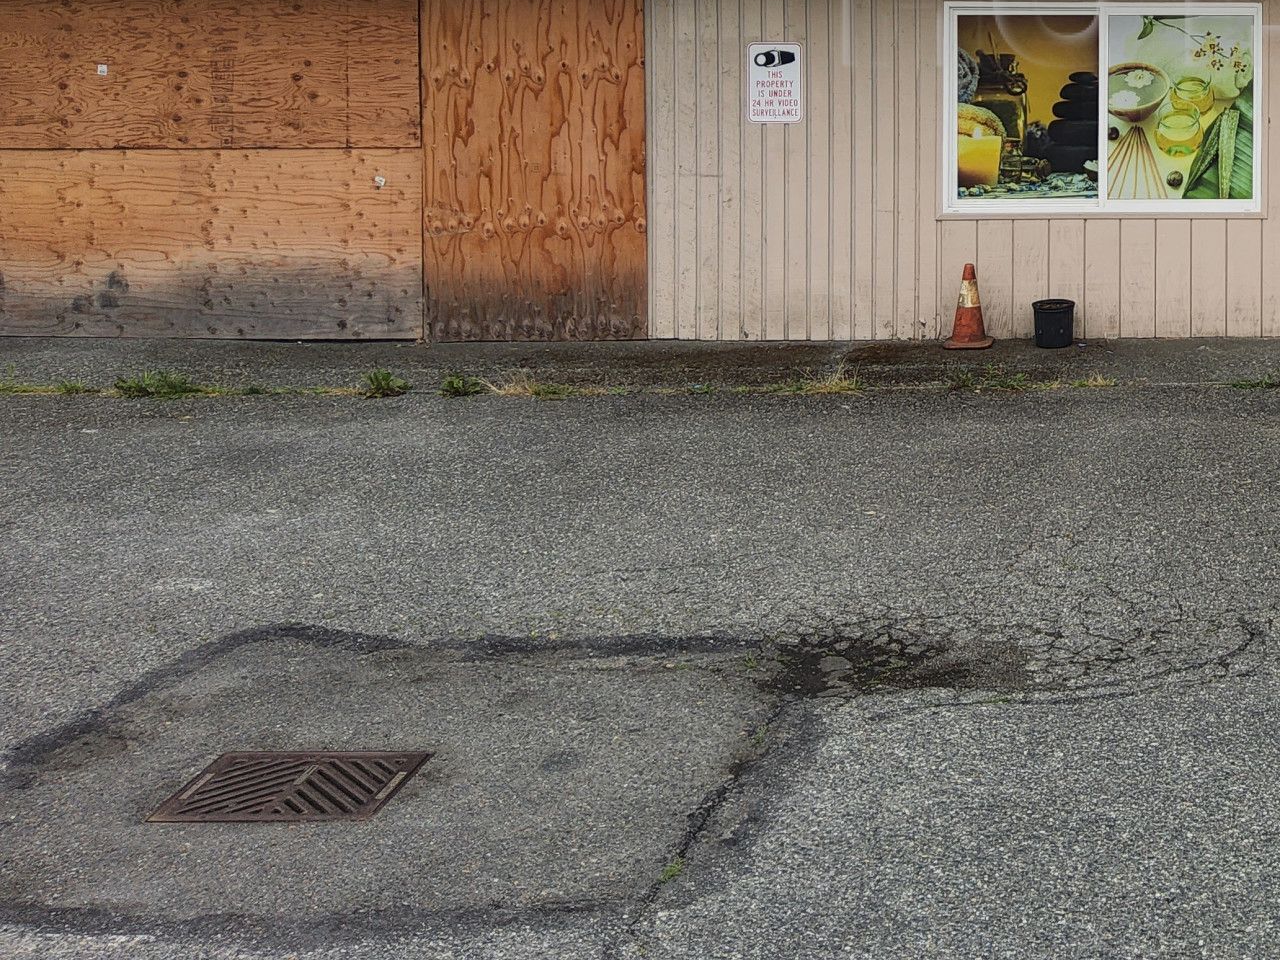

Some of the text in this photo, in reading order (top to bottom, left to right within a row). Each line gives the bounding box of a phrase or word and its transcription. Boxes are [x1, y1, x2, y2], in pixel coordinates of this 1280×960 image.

[767, 70, 783, 79] THIS
[756, 80, 794, 88] PROPERTY
[752, 109, 799, 117] SURVEILLANCE
